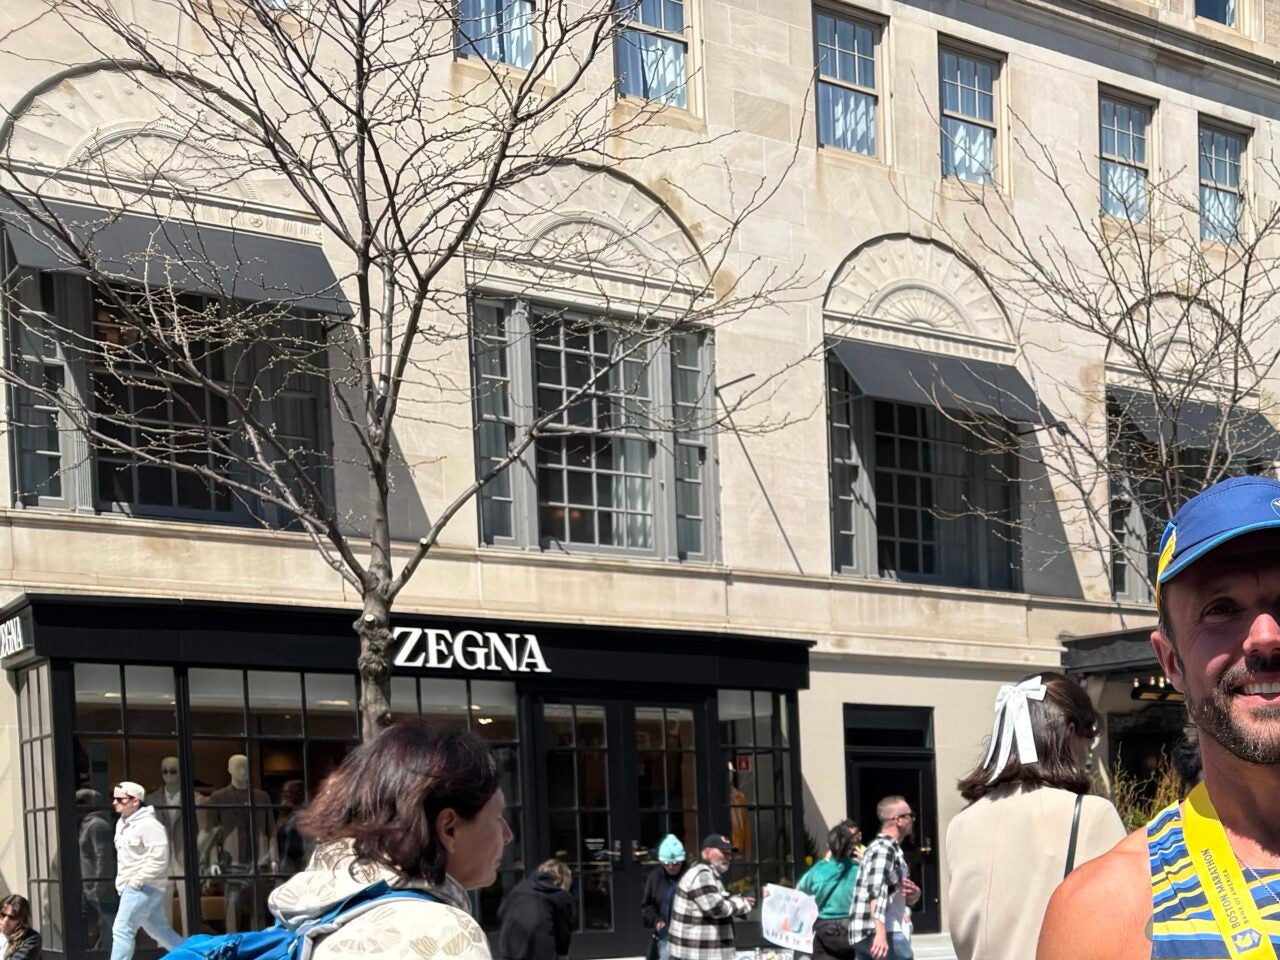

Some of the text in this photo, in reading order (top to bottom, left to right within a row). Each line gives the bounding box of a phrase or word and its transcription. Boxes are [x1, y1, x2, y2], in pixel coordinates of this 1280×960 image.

[392, 627, 552, 673] ZEGNA
[1201, 848, 1240, 929] BOSTON MARATHON
